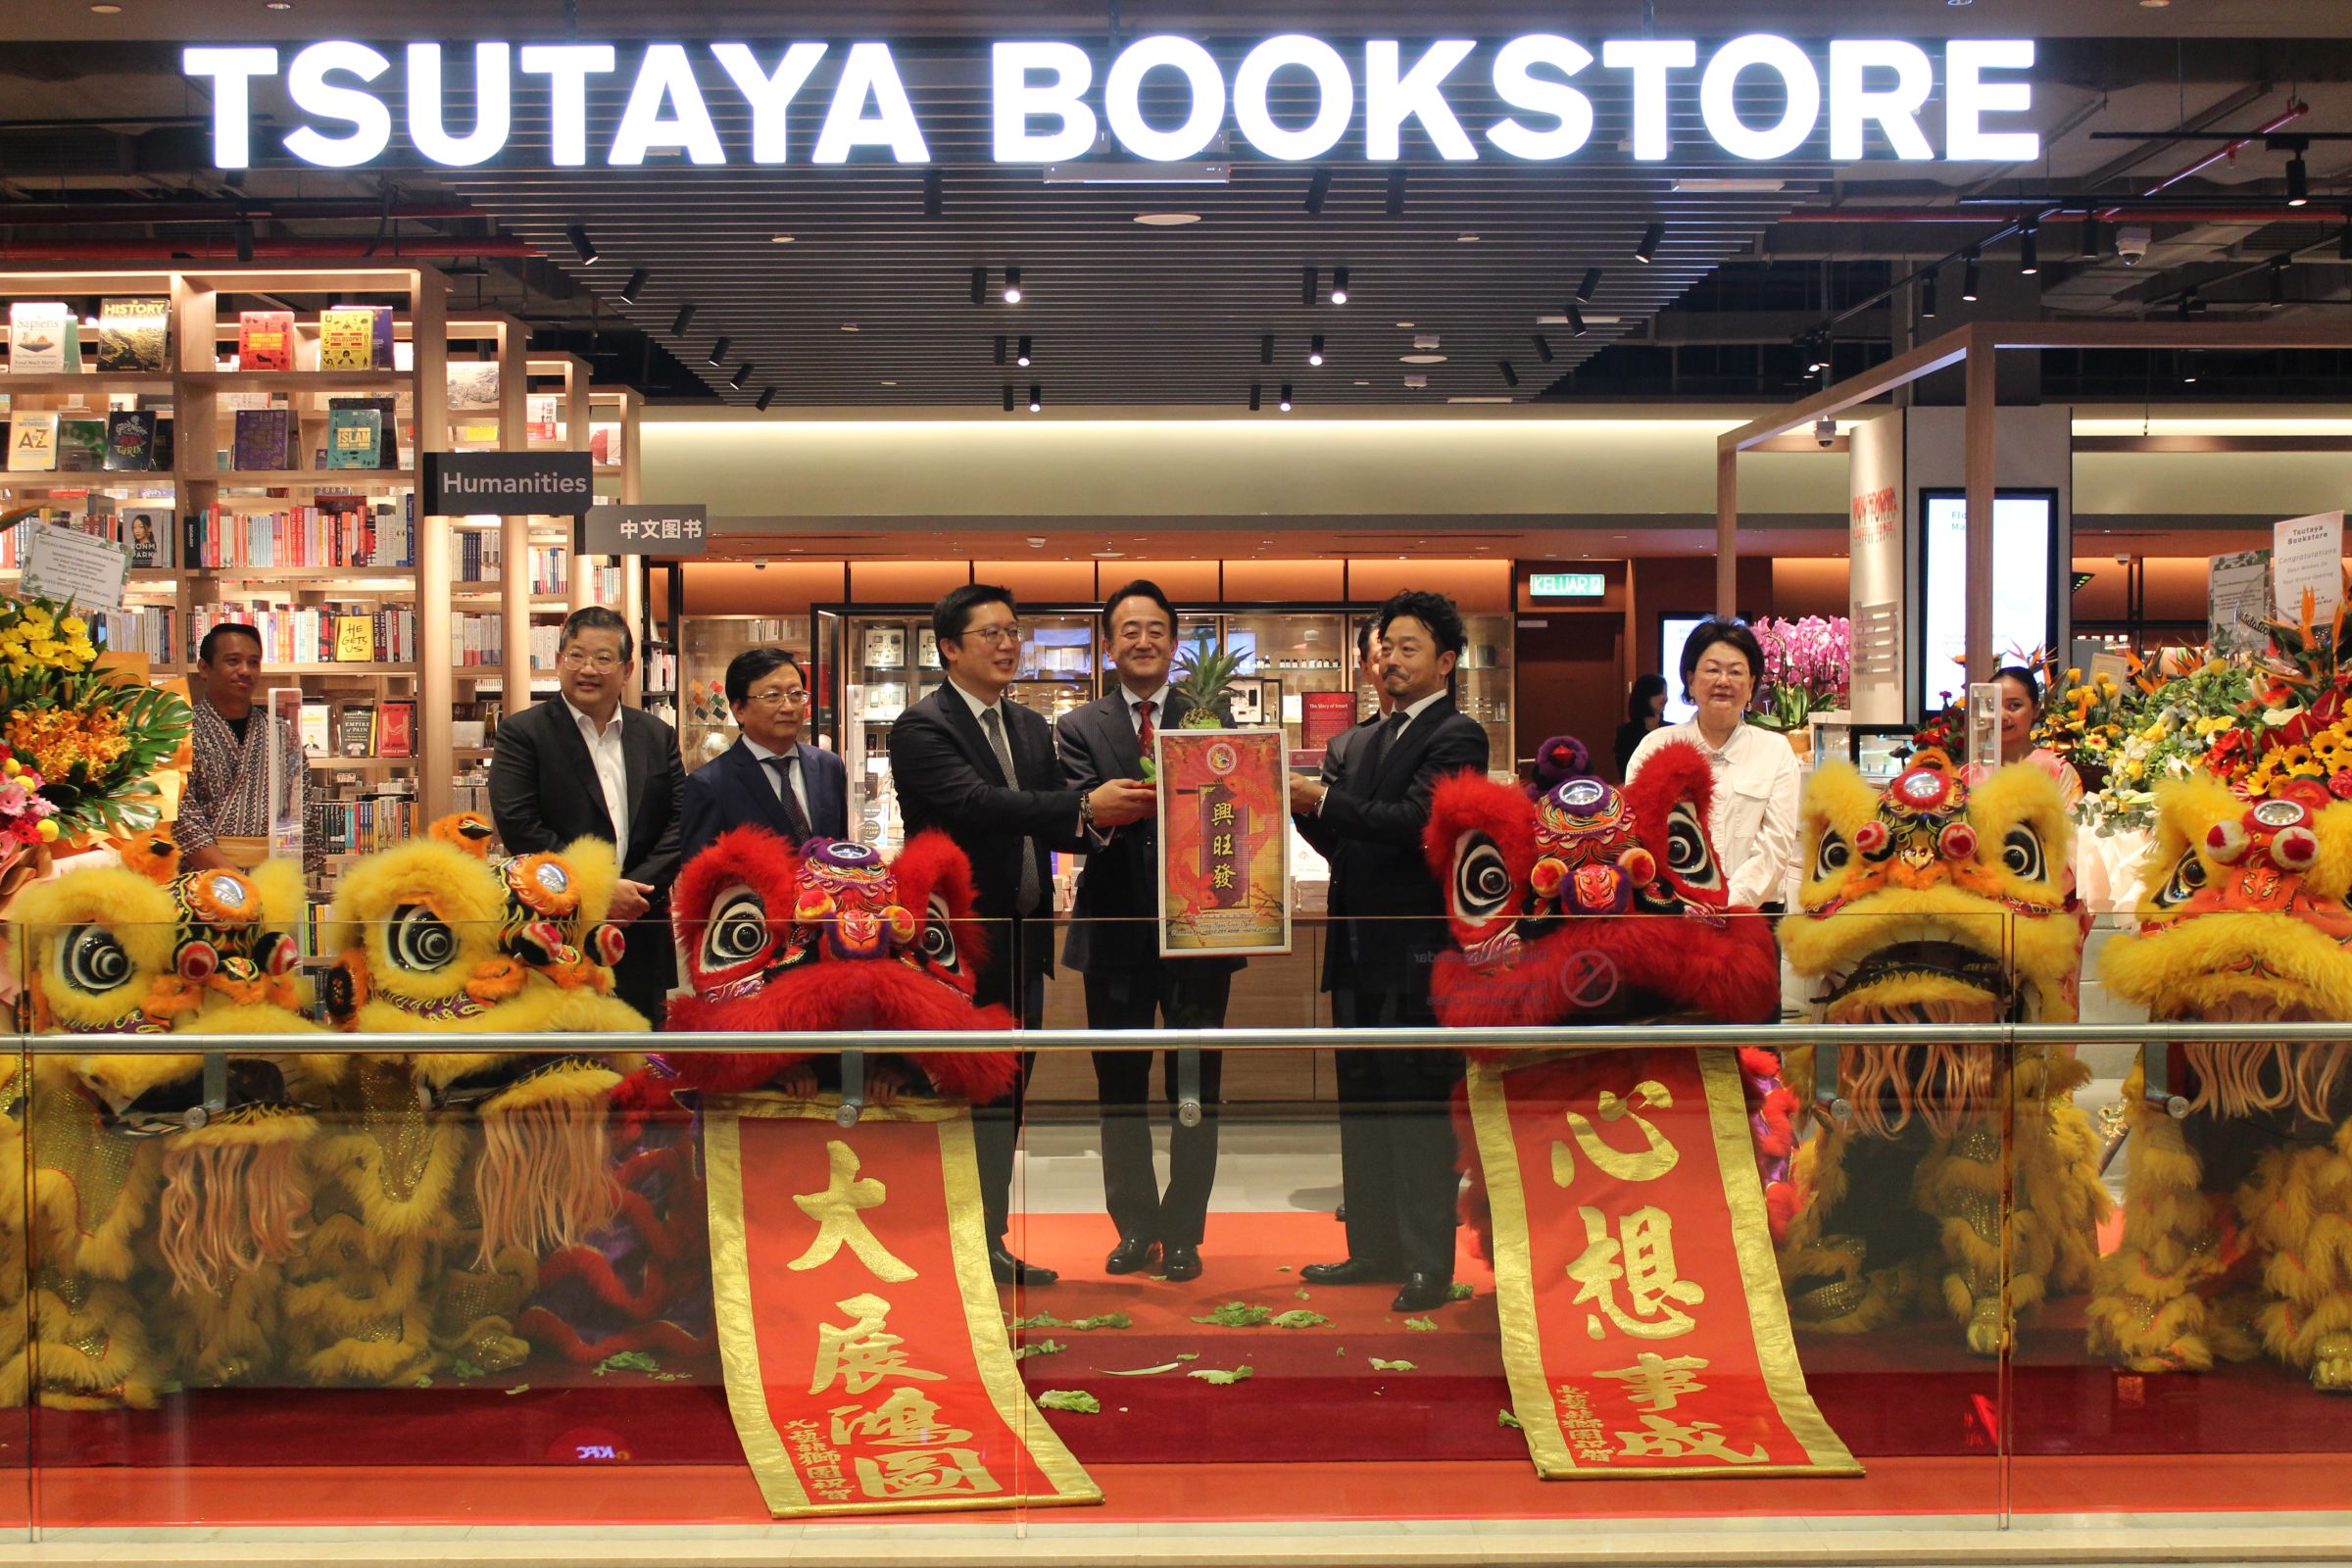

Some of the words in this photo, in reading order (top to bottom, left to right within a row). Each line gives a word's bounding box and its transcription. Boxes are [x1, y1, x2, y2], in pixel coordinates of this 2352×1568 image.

[183, 40, 931, 169] TSUTAYA
[992, 34, 2040, 163] BOOKSTORE
[104, 304, 166, 315] HISTORY
[17, 318, 60, 331] Sapiens
[18, 432, 32, 449] A
[35, 428, 48, 449] Z
[337, 430, 371, 443] ISLAM
[443, 471, 588, 494] Humanities
[620, 518, 703, 540] 中文图书
[2292, 525, 2324, 536] Tsutaya
[2287, 532, 2328, 545] Bookstore
[2278, 548, 2337, 564] Congratulations
[1534, 576, 1589, 594] KELUAR
[346, 622, 364, 635] HE
[342, 636, 368, 647] GETS
[345, 645, 364, 654] US
[1210, 802, 1237, 890] 興旺發
[1550, 1080, 1770, 1465] 心想事成
[787, 1140, 1003, 1498] 大展鴻圖
